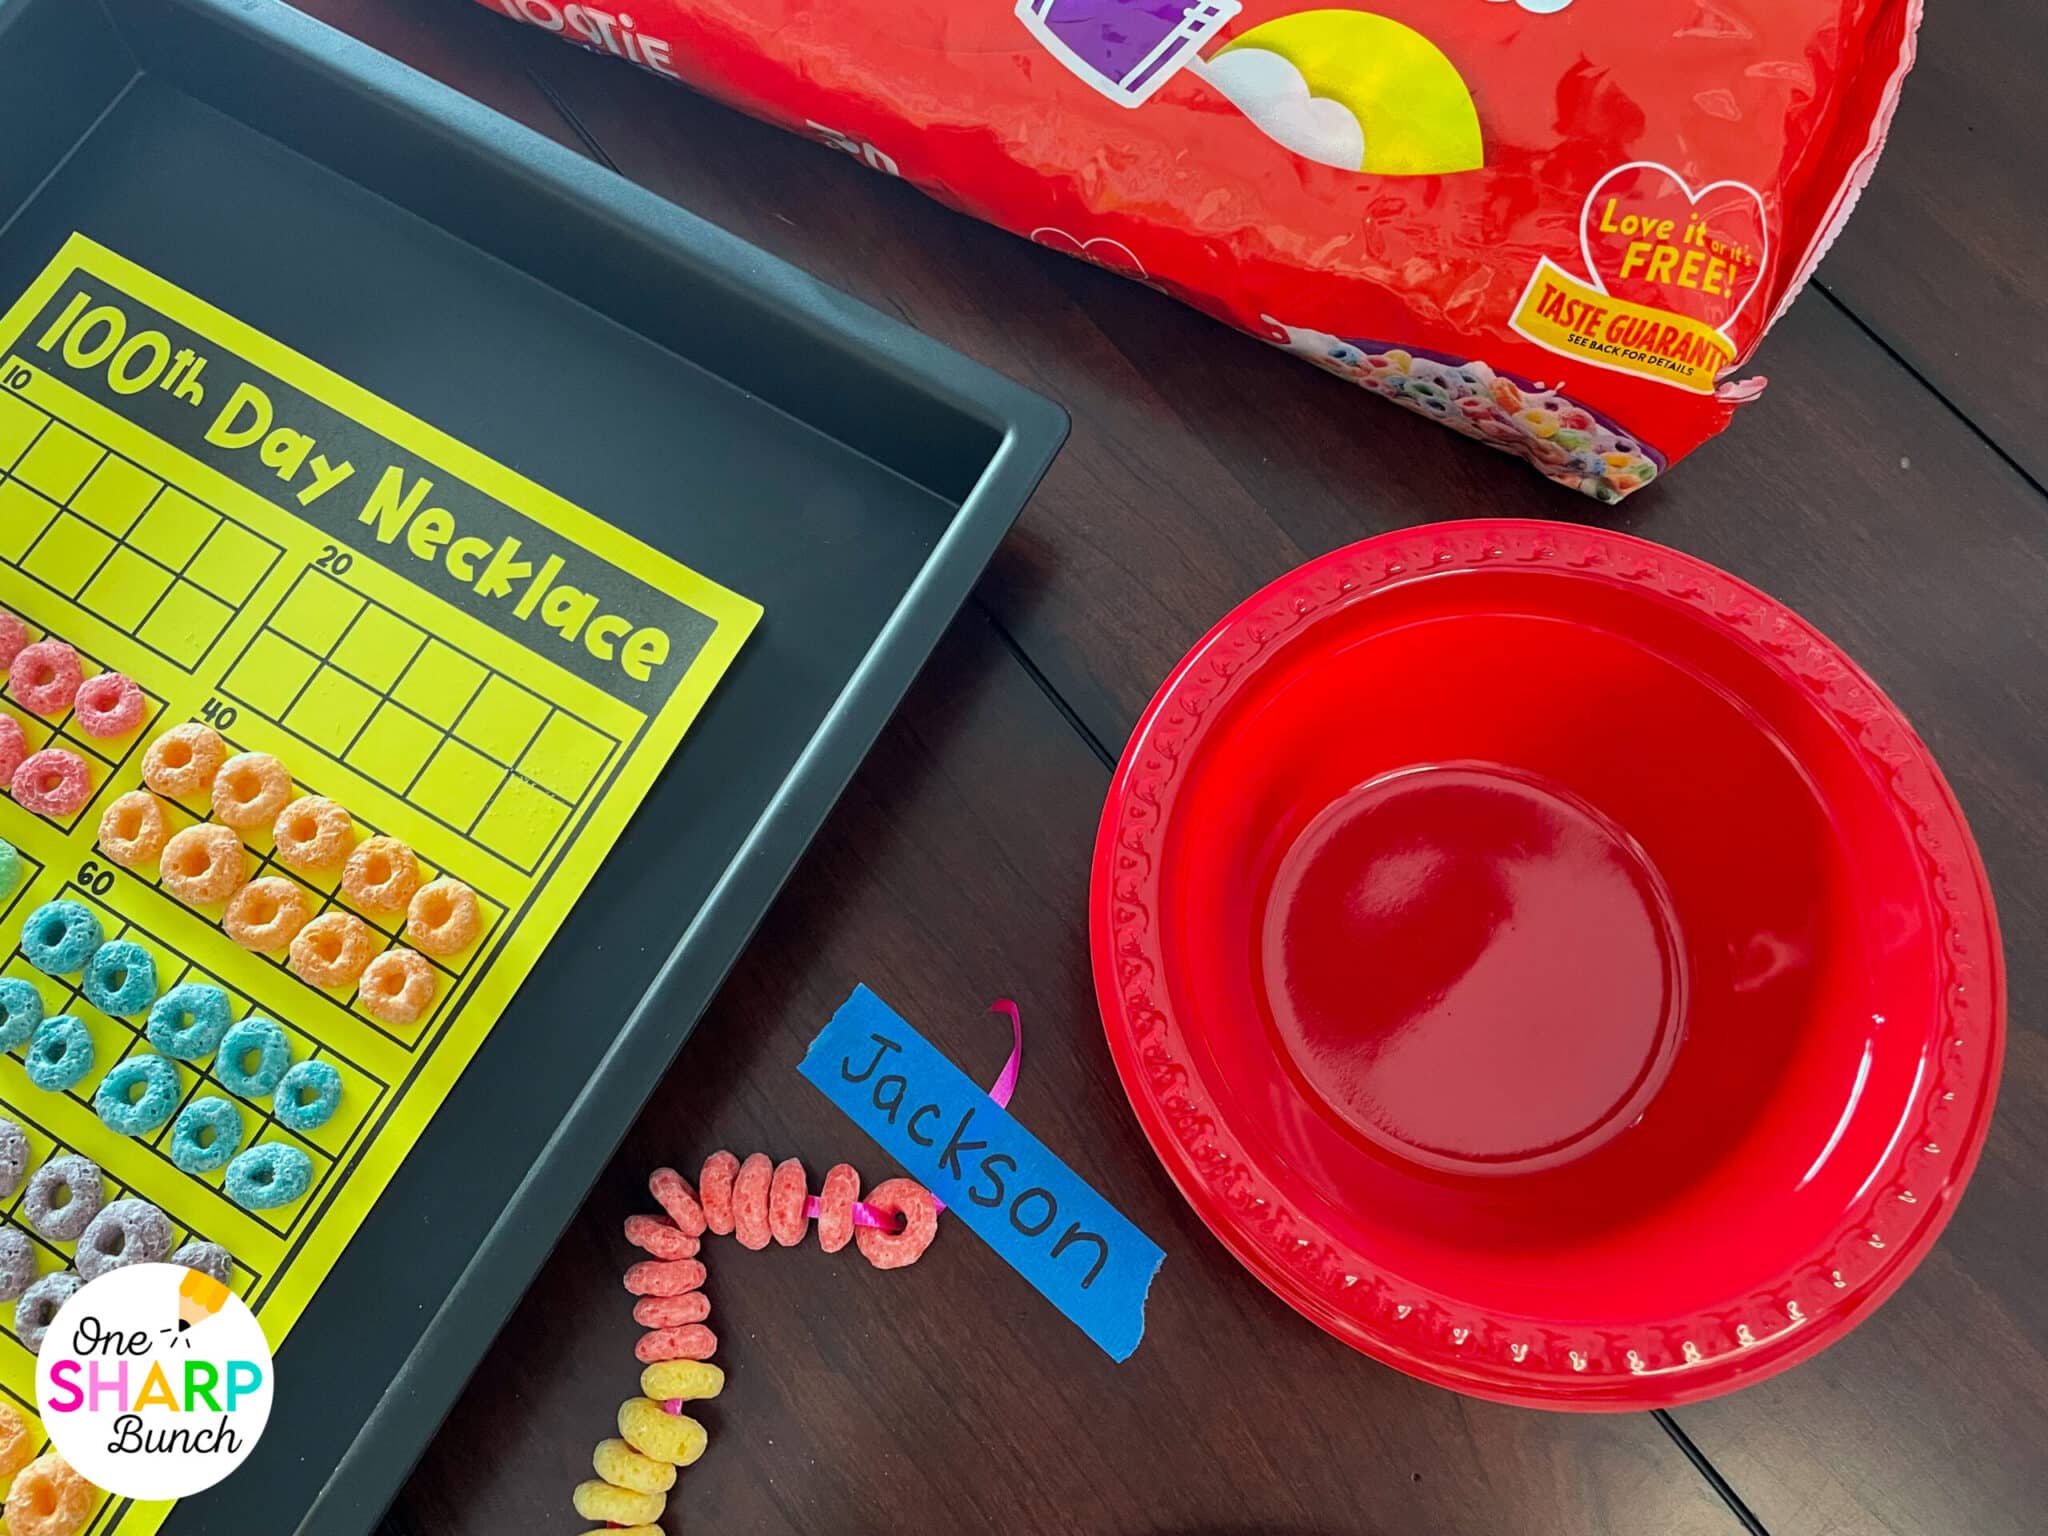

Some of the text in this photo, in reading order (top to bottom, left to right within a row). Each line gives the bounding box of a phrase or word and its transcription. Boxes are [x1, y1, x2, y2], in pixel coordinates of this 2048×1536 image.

[1599, 197, 1753, 267] Love it or it's
[1618, 241, 1738, 299] FREE!
[1535, 282, 1609, 339] TASTE
[2, 364, 33, 391] 10
[1567, 333, 1695, 377] SEE BACK FOR DETAILS
[36, 290, 671, 683] 100th Day Necklace
[315, 544, 354, 576] 20
[200, 696, 238, 731] 40
[76, 860, 116, 896] 60
[841, 1033, 1109, 1290] Jackson
